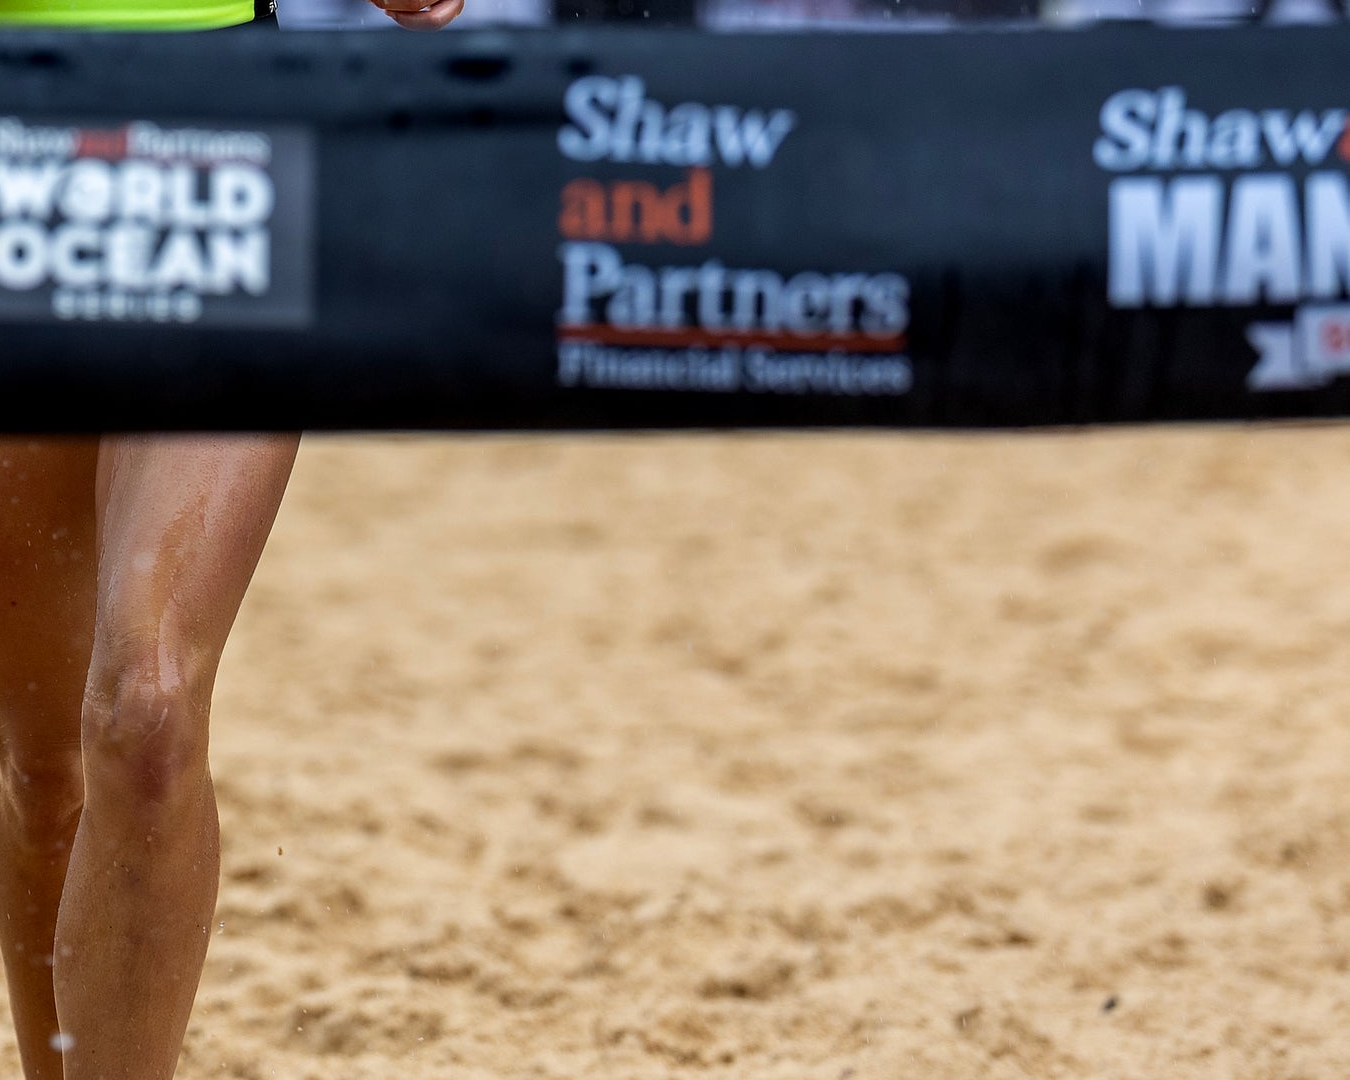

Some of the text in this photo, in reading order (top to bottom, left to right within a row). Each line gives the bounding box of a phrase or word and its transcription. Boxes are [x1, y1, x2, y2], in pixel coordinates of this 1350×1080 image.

[558, 75, 794, 168] Shaw
[1092, 84, 1350, 171] Shaw
[557, 169, 714, 245] and
[558, 242, 911, 334] Partners
[558, 344, 912, 396] Financial Services
